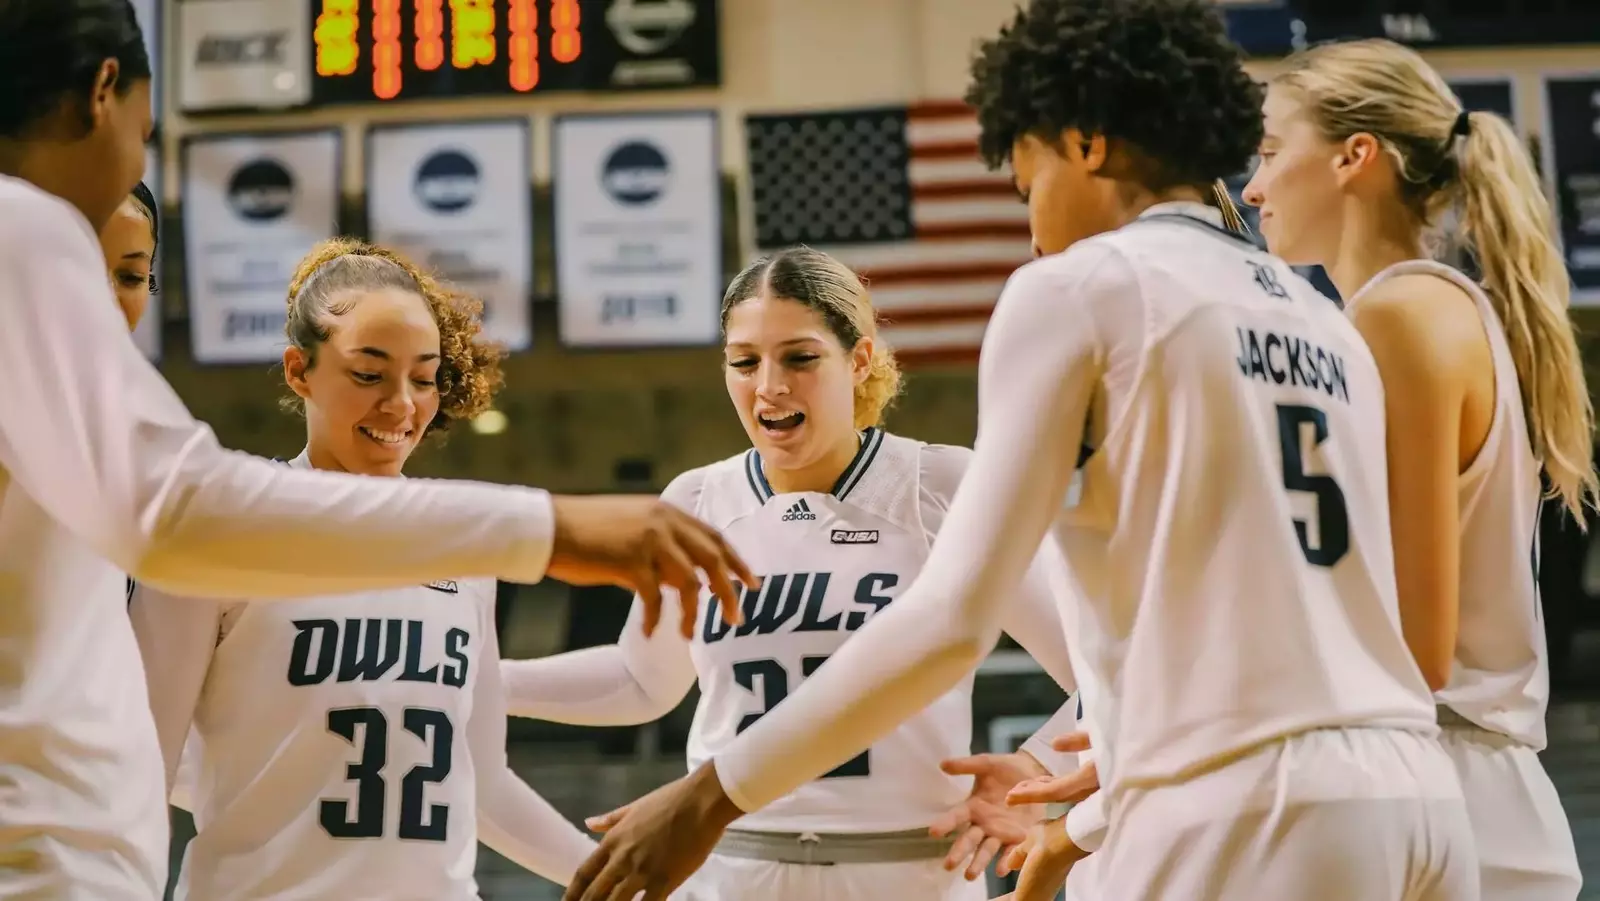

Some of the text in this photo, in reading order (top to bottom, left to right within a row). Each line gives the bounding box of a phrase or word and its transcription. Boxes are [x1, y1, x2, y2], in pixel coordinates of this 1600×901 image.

[1236, 326, 1350, 404] JACKSON
[781, 512, 816, 521] adidas
[1276, 404, 1350, 567] 5
[287, 618, 470, 689] OWLS
[318, 705, 453, 841] 32
